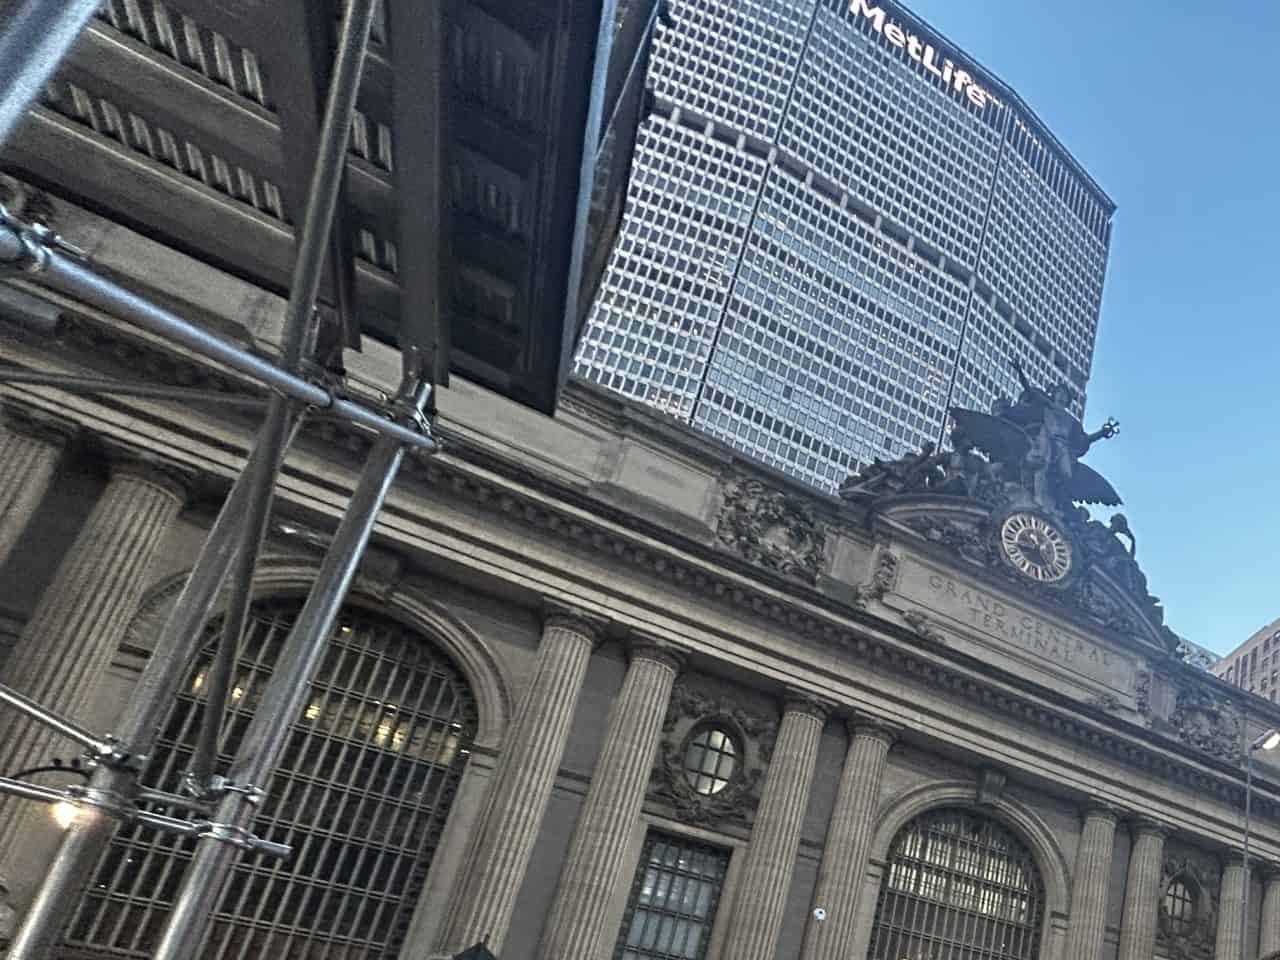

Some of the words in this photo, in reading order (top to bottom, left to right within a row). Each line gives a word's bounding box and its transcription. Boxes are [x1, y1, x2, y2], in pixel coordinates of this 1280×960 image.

[850, 0, 988, 107] MetLife
[928, 574, 1006, 617] GRAND
[1020, 614, 1115, 666] CENTRAL
[967, 607, 1074, 663] TERMINAL
